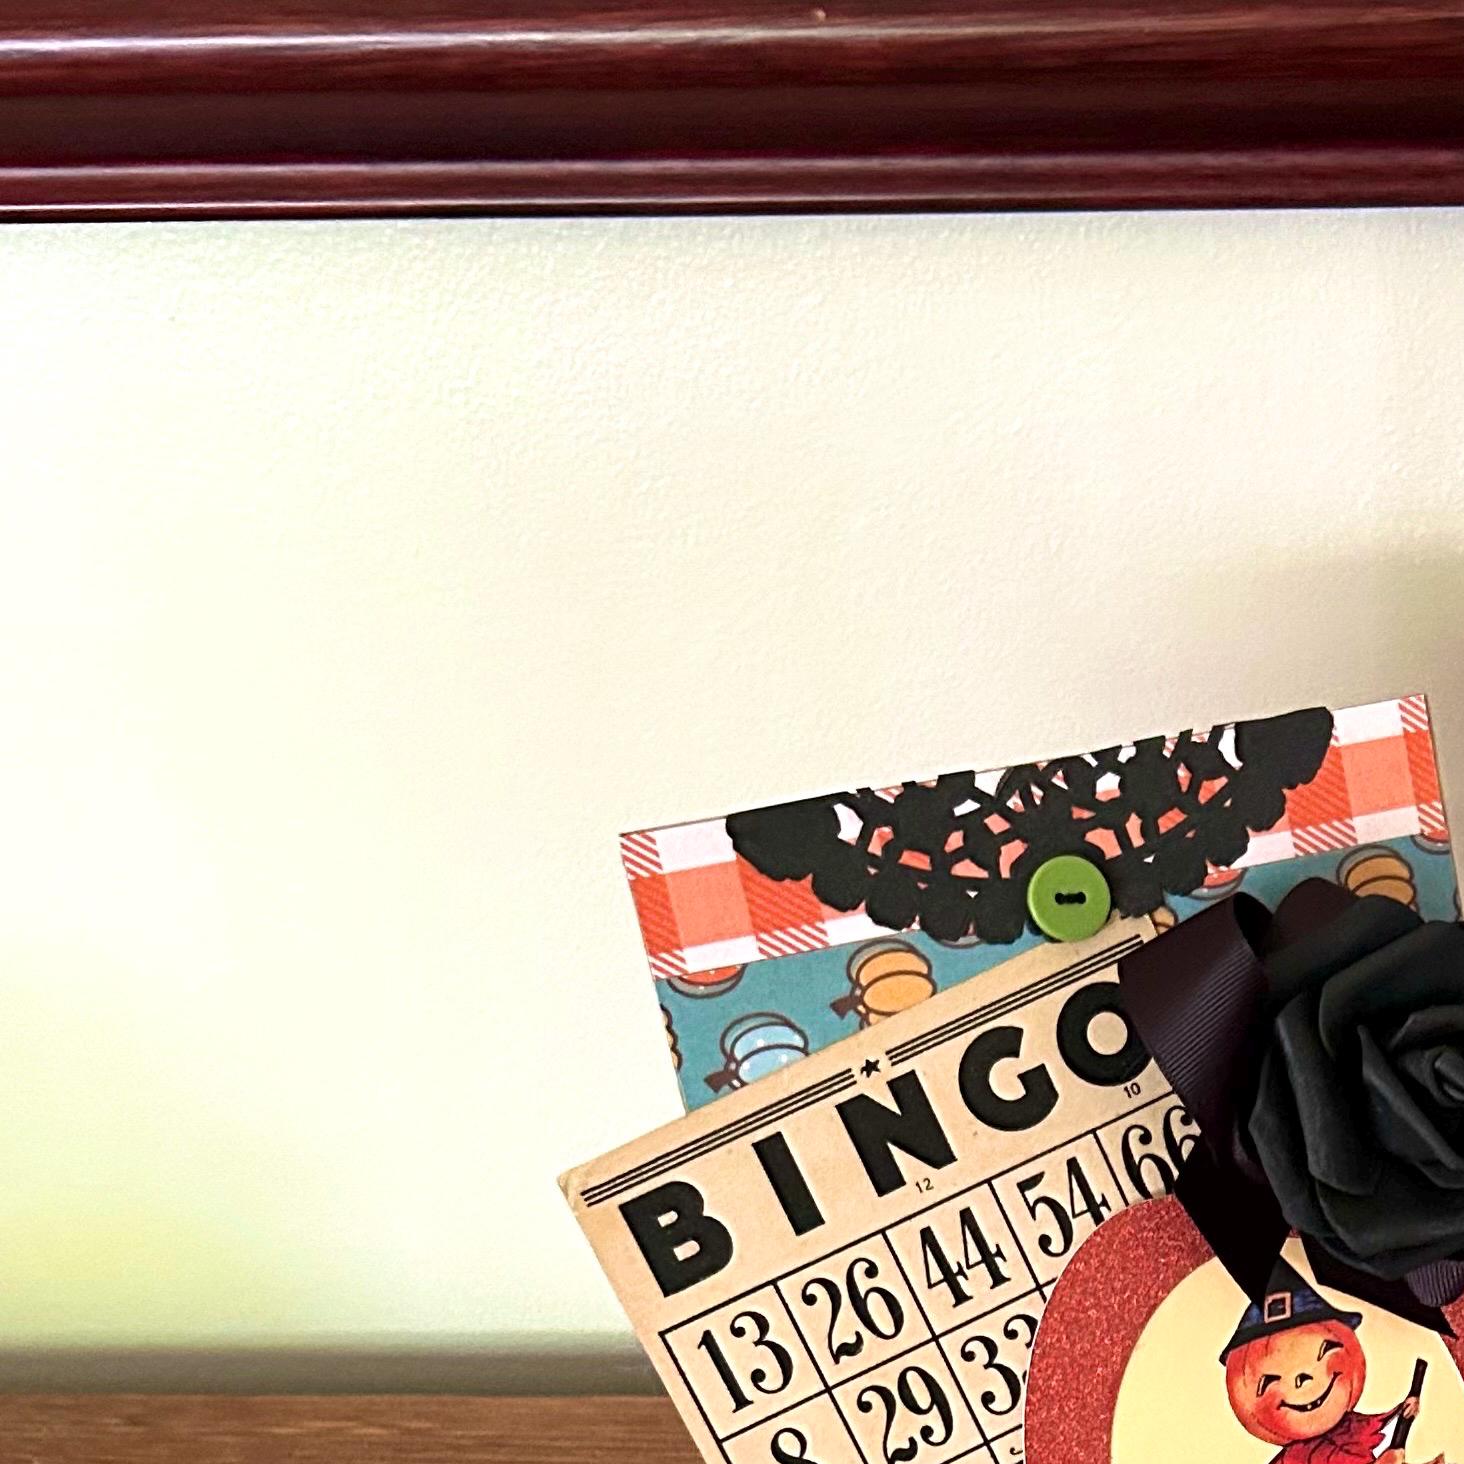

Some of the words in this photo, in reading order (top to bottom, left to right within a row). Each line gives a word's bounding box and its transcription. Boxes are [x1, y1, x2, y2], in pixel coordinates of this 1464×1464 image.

[618, 982, 1154, 1298] BINGO
[1124, 1082, 1141, 1099] 10
[697, 1310, 795, 1414] 13
[801, 1257, 905, 1365] 26
[919, 1206, 1011, 1309] 44
[1017, 1157, 1111, 1260] 54
[1121, 1105, 1202, 1200] 66
[914, 1177, 935, 1194] 12
